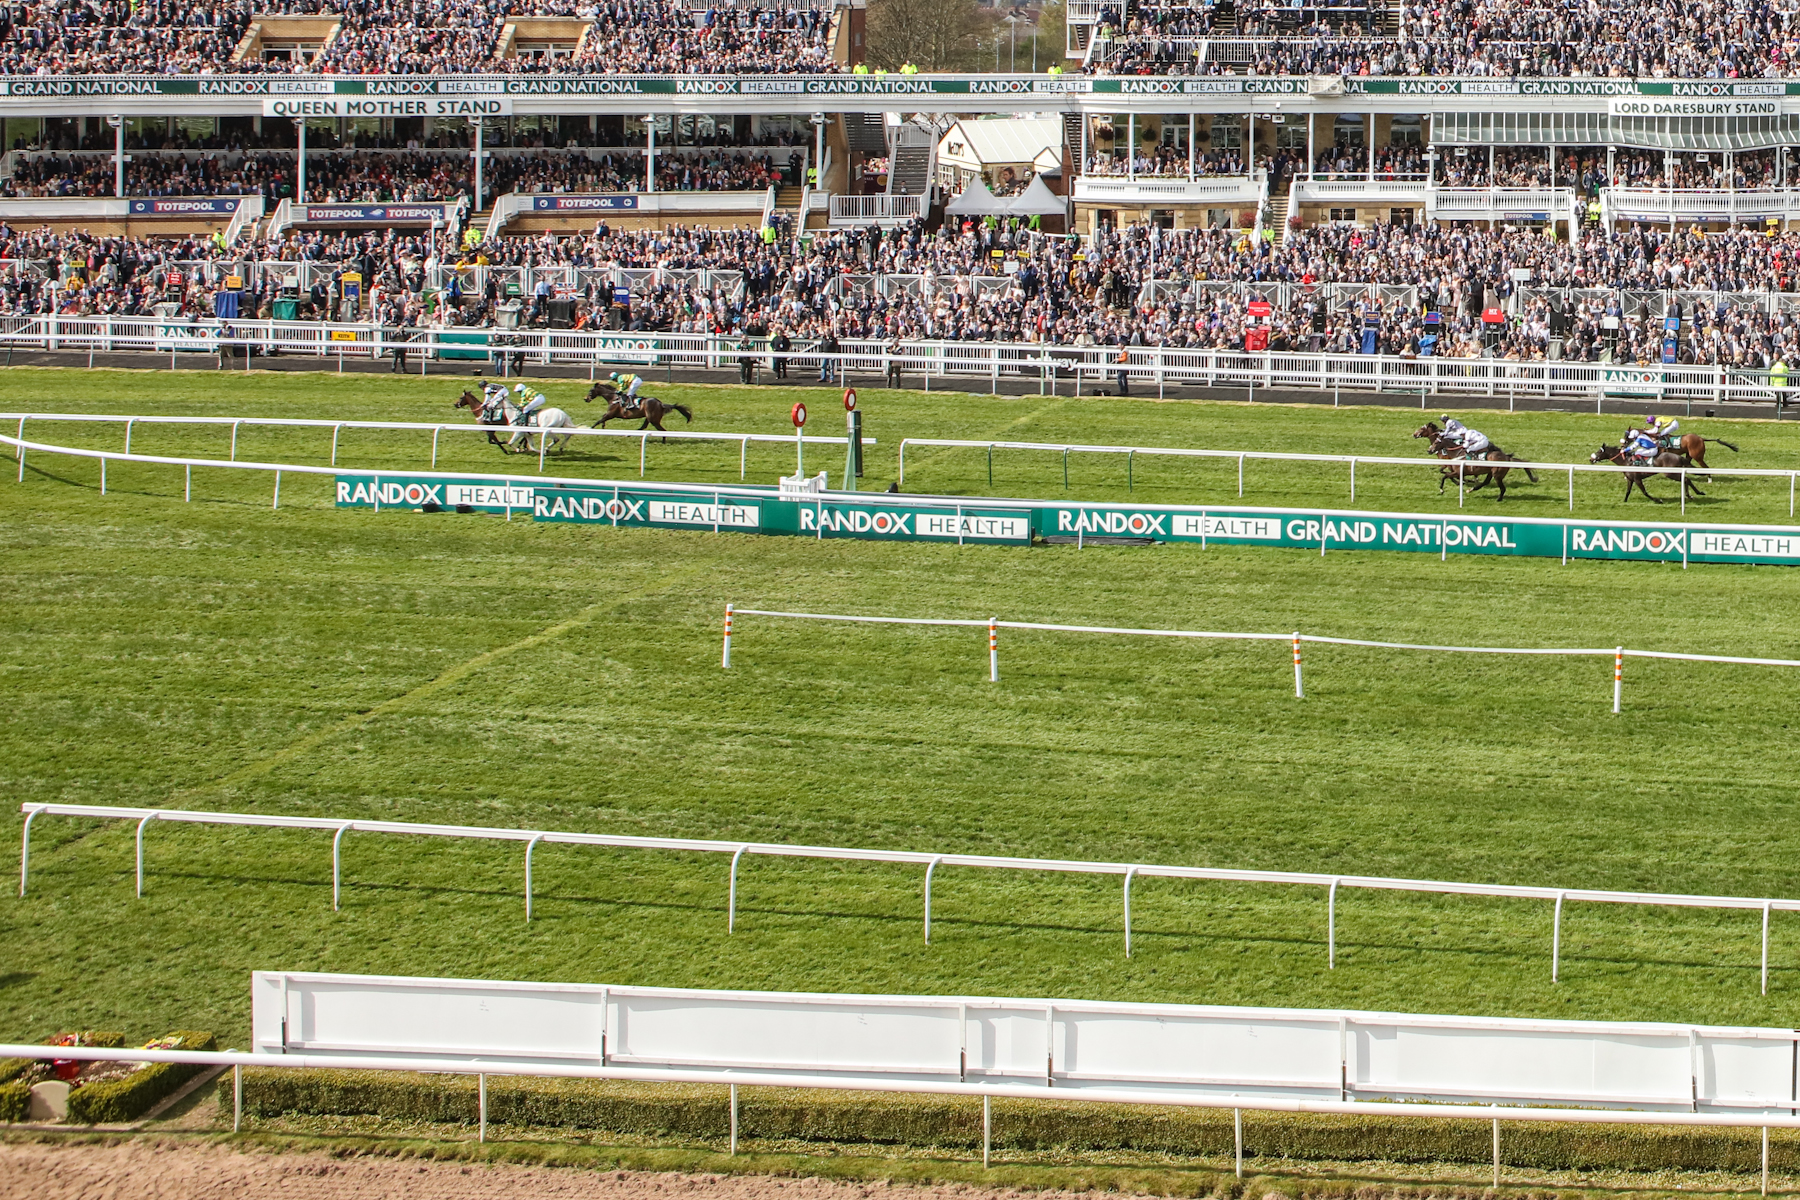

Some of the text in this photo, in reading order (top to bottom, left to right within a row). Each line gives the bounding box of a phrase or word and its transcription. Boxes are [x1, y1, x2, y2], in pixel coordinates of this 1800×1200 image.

[12, 81, 162, 95] GRAND NATIONAL
[198, 81, 327, 94] RANDOX HEALTH
[366, 81, 642, 94] RANDOX HEALTH GRAND NATIONAL
[676, 81, 936, 93] RANDOX HEALTH GRAND NATIONAL
[969, 81, 1086, 93] RANDOX HEALTH
[1121, 81, 1180, 93] RANDOX
[1191, 82, 1236, 92] HEALTH
[1245, 81, 1293, 93] GRAND
[1399, 82, 1642, 95] RANDOX HEALTH GRAND NATIONAL
[1672, 83, 1784, 95] RANDOX HEALTH
[272, 101, 502, 115] QUEEN MOTHER STAND
[1614, 102, 1776, 115] LORD DARESBURY STAND
[157, 201, 215, 211] TOTEPOOL
[560, 198, 614, 208] TOTEPOOL
[310, 208, 443, 218] TOTEPOOL TOTEPOOL
[595, 339, 658, 350] RANDOX
[336, 481, 443, 506] RANDOX
[535, 493, 746, 524] RANDOX HEALTH
[800, 507, 1015, 536] RANDOX HEALTH
[1058, 509, 1516, 548] RANDOX HEALTH GRAND NATIONAL
[1572, 528, 1684, 553] RANDOX
[1704, 536, 1791, 554] HEALTH
